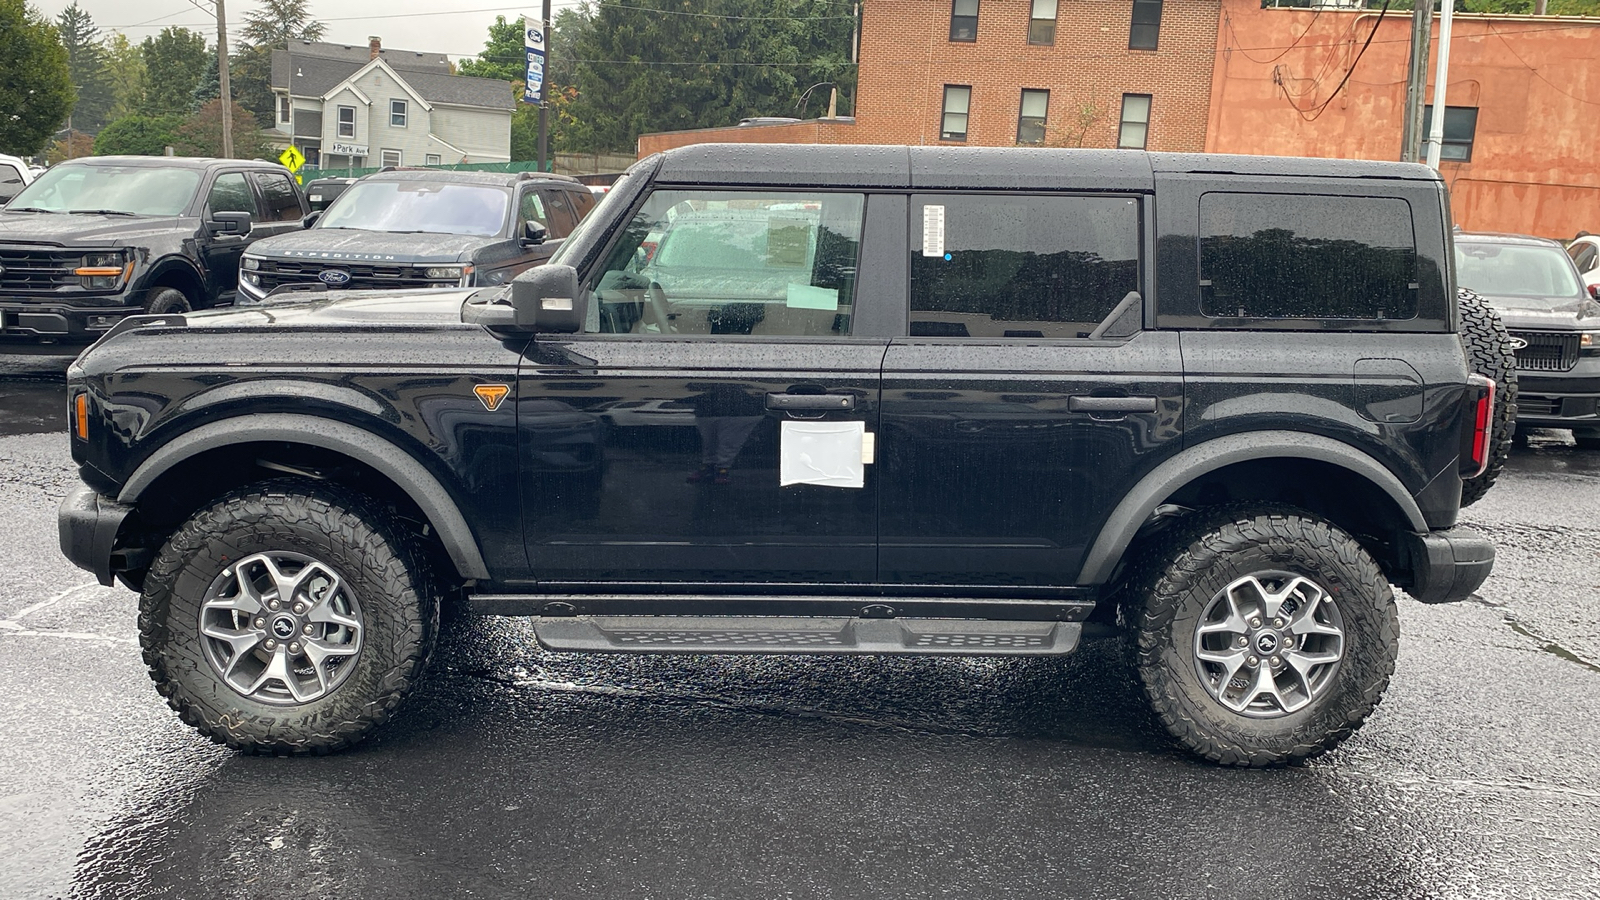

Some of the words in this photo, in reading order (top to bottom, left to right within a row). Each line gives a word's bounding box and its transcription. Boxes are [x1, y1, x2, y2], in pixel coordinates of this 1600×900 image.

[336, 143, 353, 153] Park
[284, 251, 394, 260] EXPEDITION
[324, 272, 344, 281] Ford
